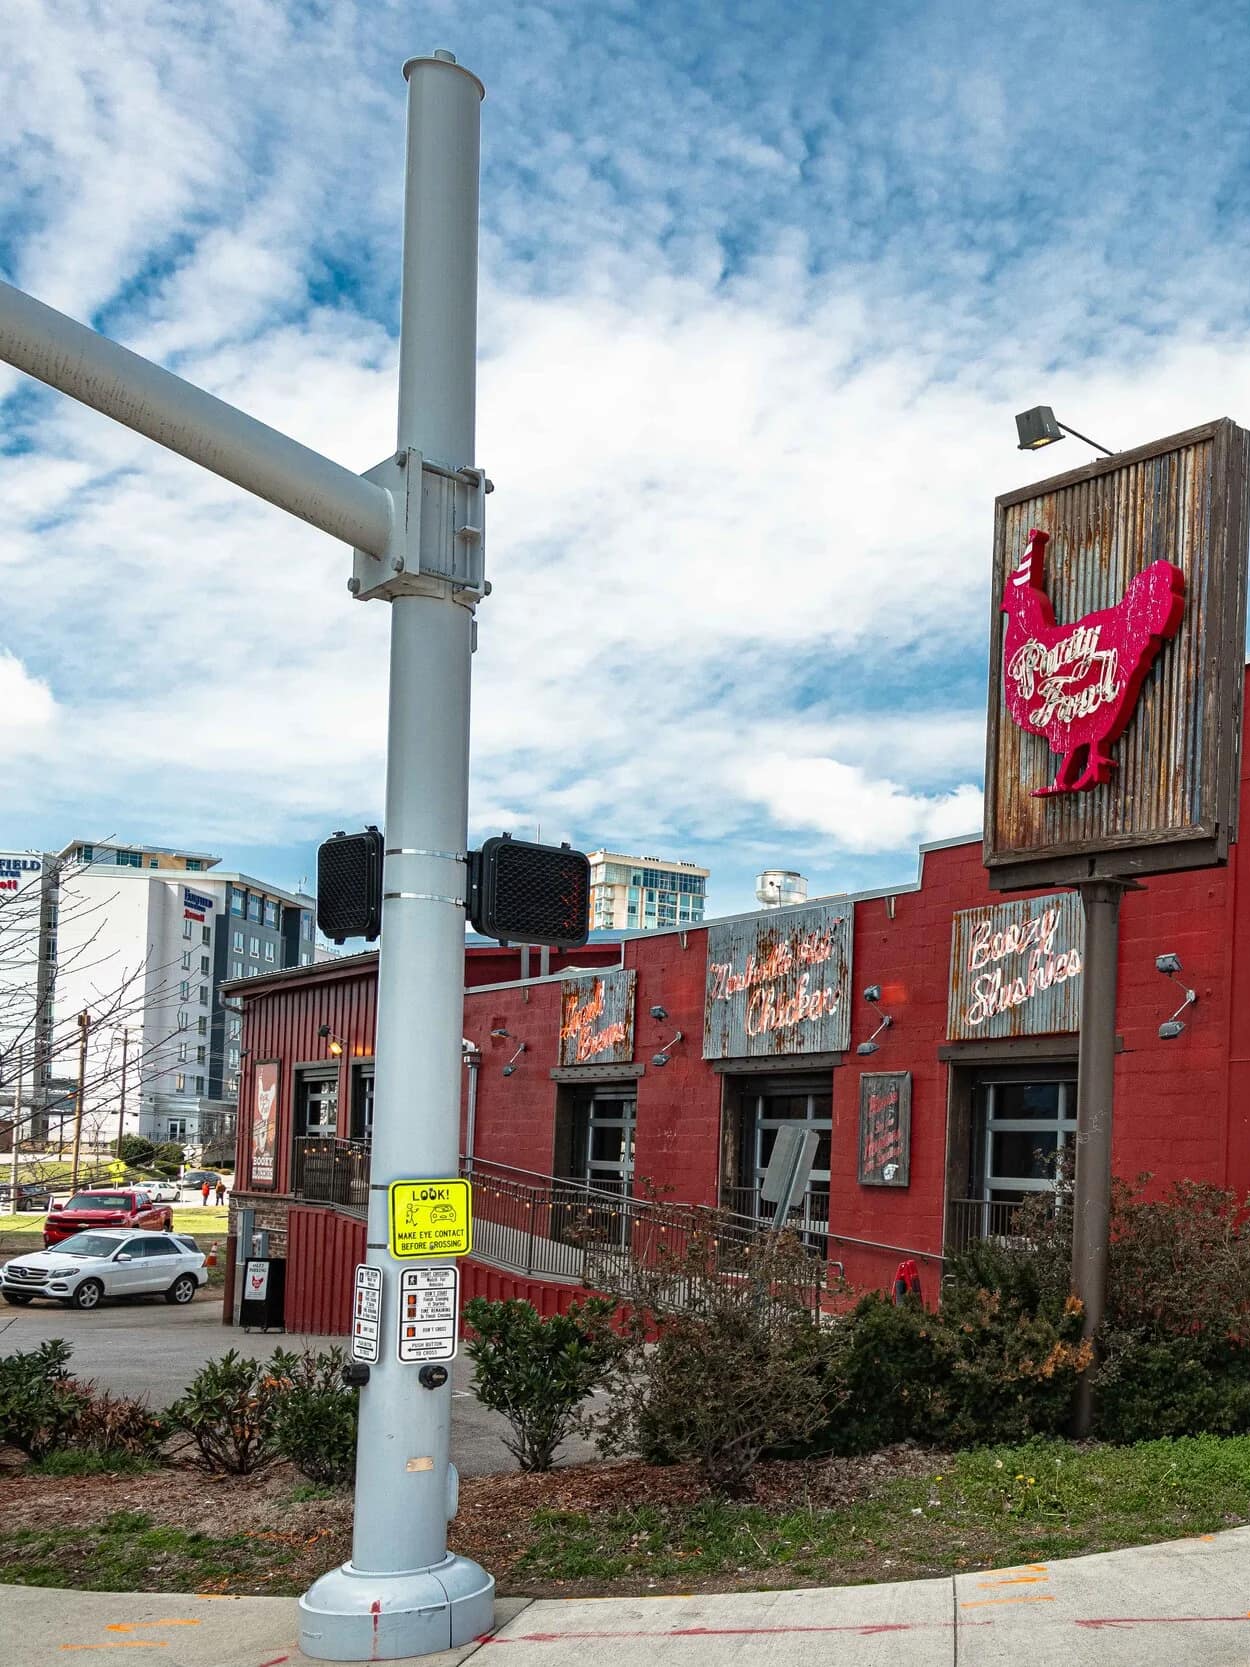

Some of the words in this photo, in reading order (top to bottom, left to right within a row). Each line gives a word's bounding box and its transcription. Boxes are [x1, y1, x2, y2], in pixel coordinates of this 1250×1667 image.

[1008, 625, 1102, 699] Party
[1030, 648, 1120, 727] Fowl
[968, 909, 1061, 973] Boozy
[745, 972, 841, 1036] Chicken
[965, 948, 1082, 1025] Slushies
[412, 1189, 449, 1201] LOOK!
[398, 1231, 416, 1240] MAKE
[420, 1230, 432, 1239] EYE
[435, 1229, 464, 1238] CONTACT
[402, 1241, 427, 1250] BEFORE
[429, 1240, 461, 1249] CROSSING
